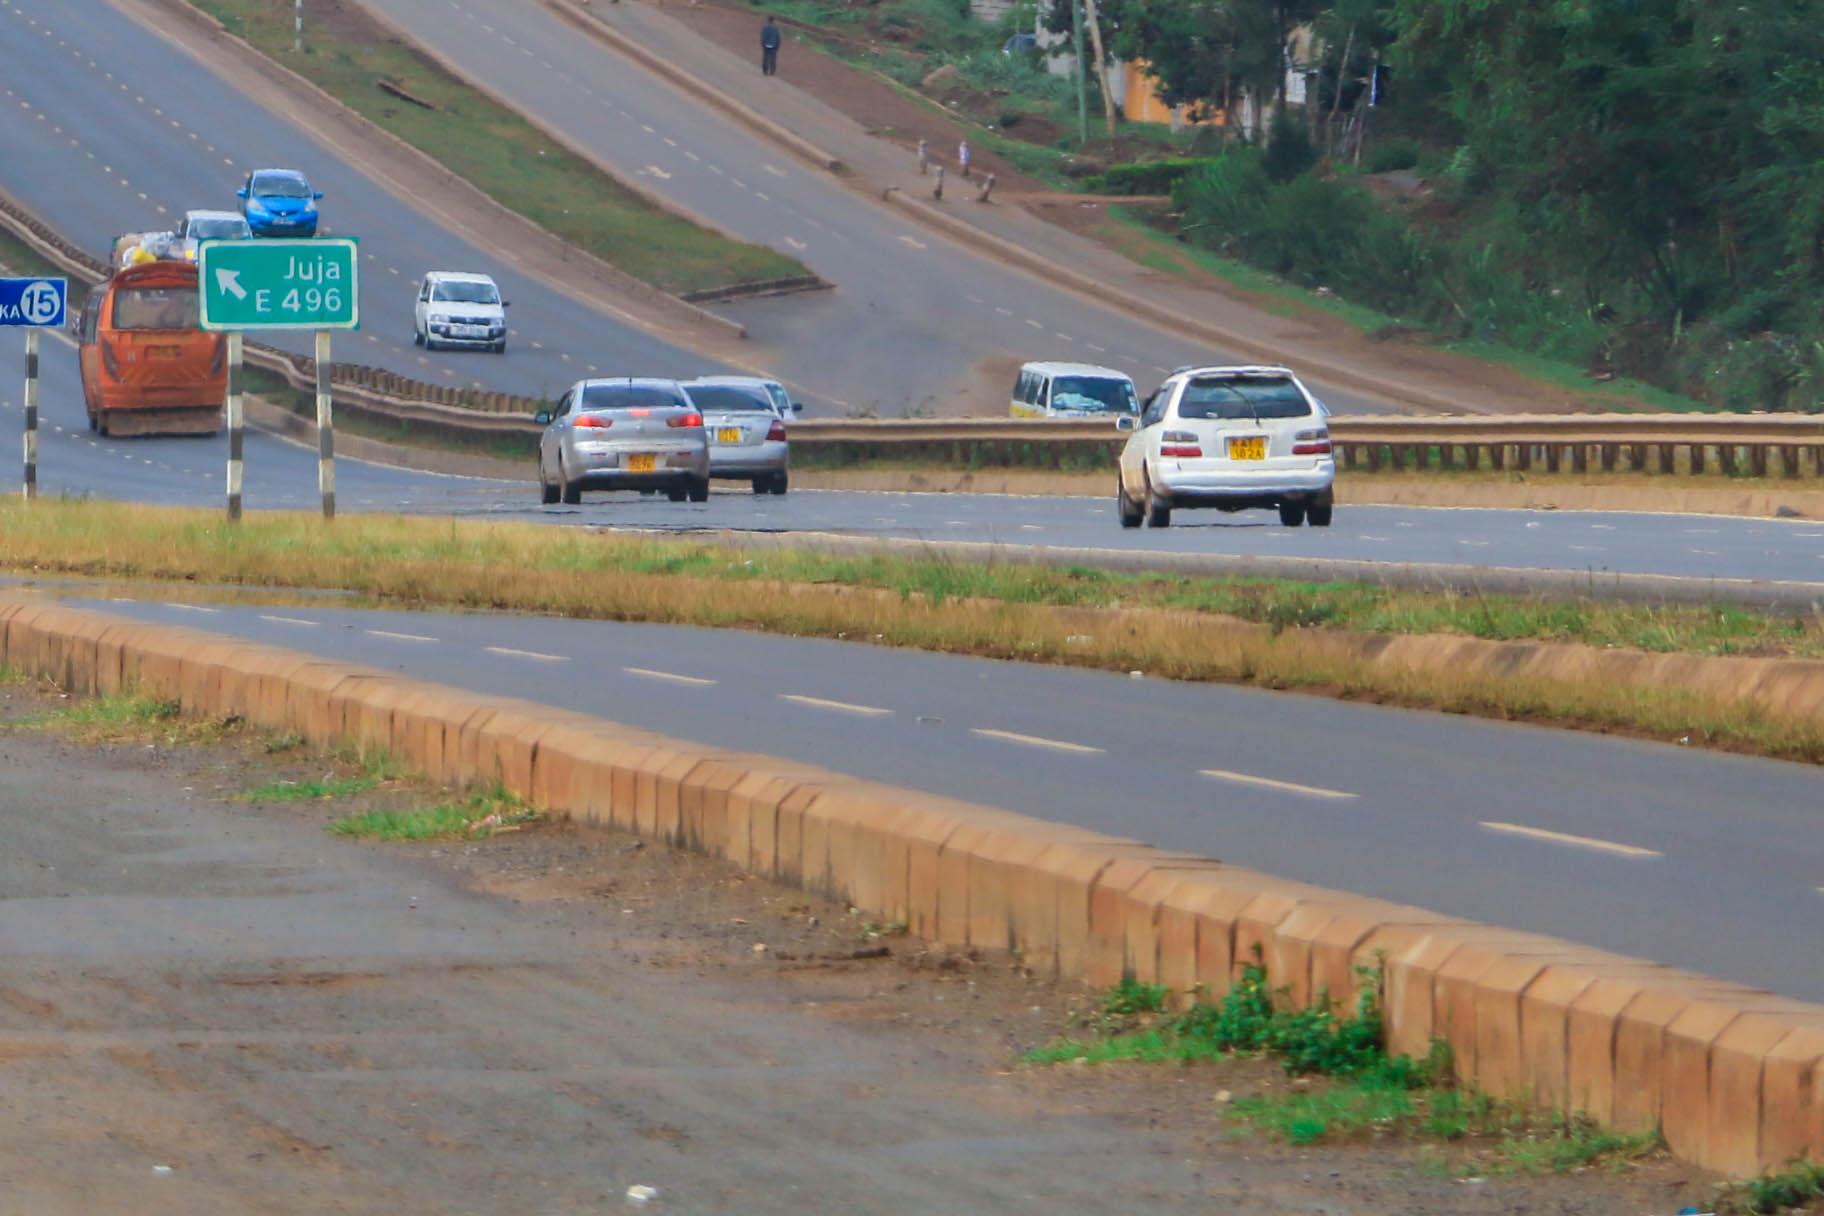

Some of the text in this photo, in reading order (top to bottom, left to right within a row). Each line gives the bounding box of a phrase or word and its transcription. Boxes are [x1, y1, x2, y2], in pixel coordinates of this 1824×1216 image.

[283, 255, 341, 284] Juja
[25, 289, 57, 317] 15
[256, 288, 342, 313] E 496
